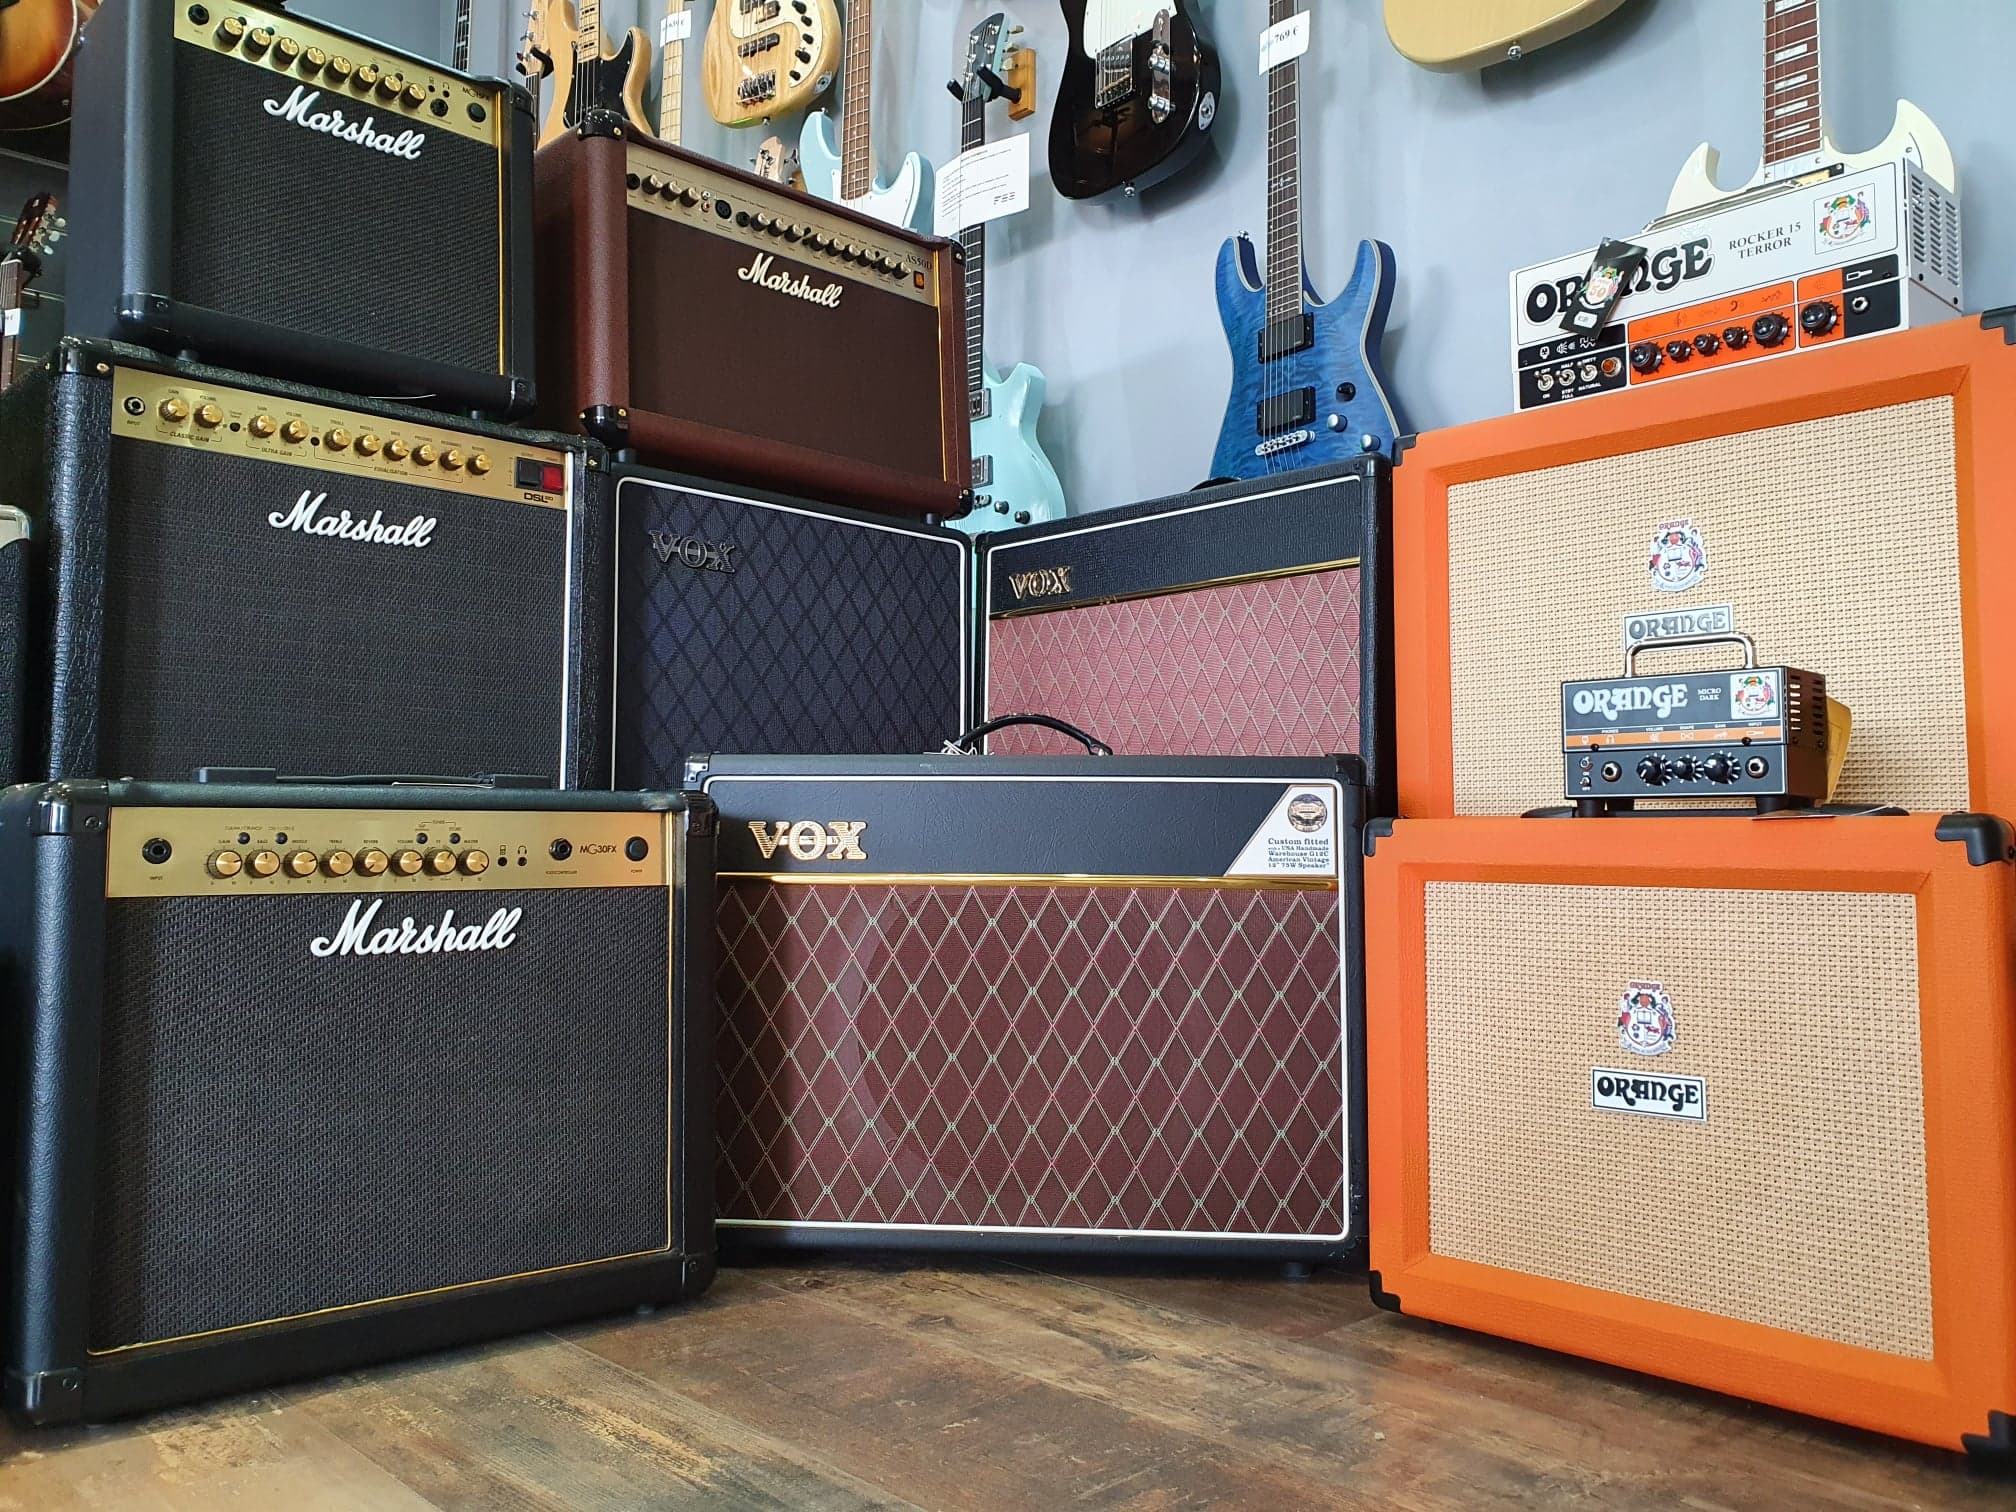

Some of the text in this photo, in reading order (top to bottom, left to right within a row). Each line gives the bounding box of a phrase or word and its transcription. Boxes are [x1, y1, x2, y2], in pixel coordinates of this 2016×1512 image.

[263, 85, 426, 160] Marshall
[1729, 222, 1801, 250] ROCKER 15
[1738, 238, 1792, 259] TERROR
[738, 253, 843, 308] Marshall
[1526, 238, 1713, 323] ORNGE
[1578, 382, 1602, 391] NATURAL
[170, 431, 194, 440] CLASSIC
[268, 490, 437, 548] Marshall
[648, 530, 736, 574] VOX
[1008, 566, 1071, 600] VOX
[1629, 610, 1726, 640] ORANGE
[1573, 684, 1688, 721] ORANGE
[580, 844, 616, 855] MG30FX
[748, 820, 868, 860] VOX
[310, 898, 522, 958] Marshall
[1597, 1076, 1699, 1112] ORANGE
